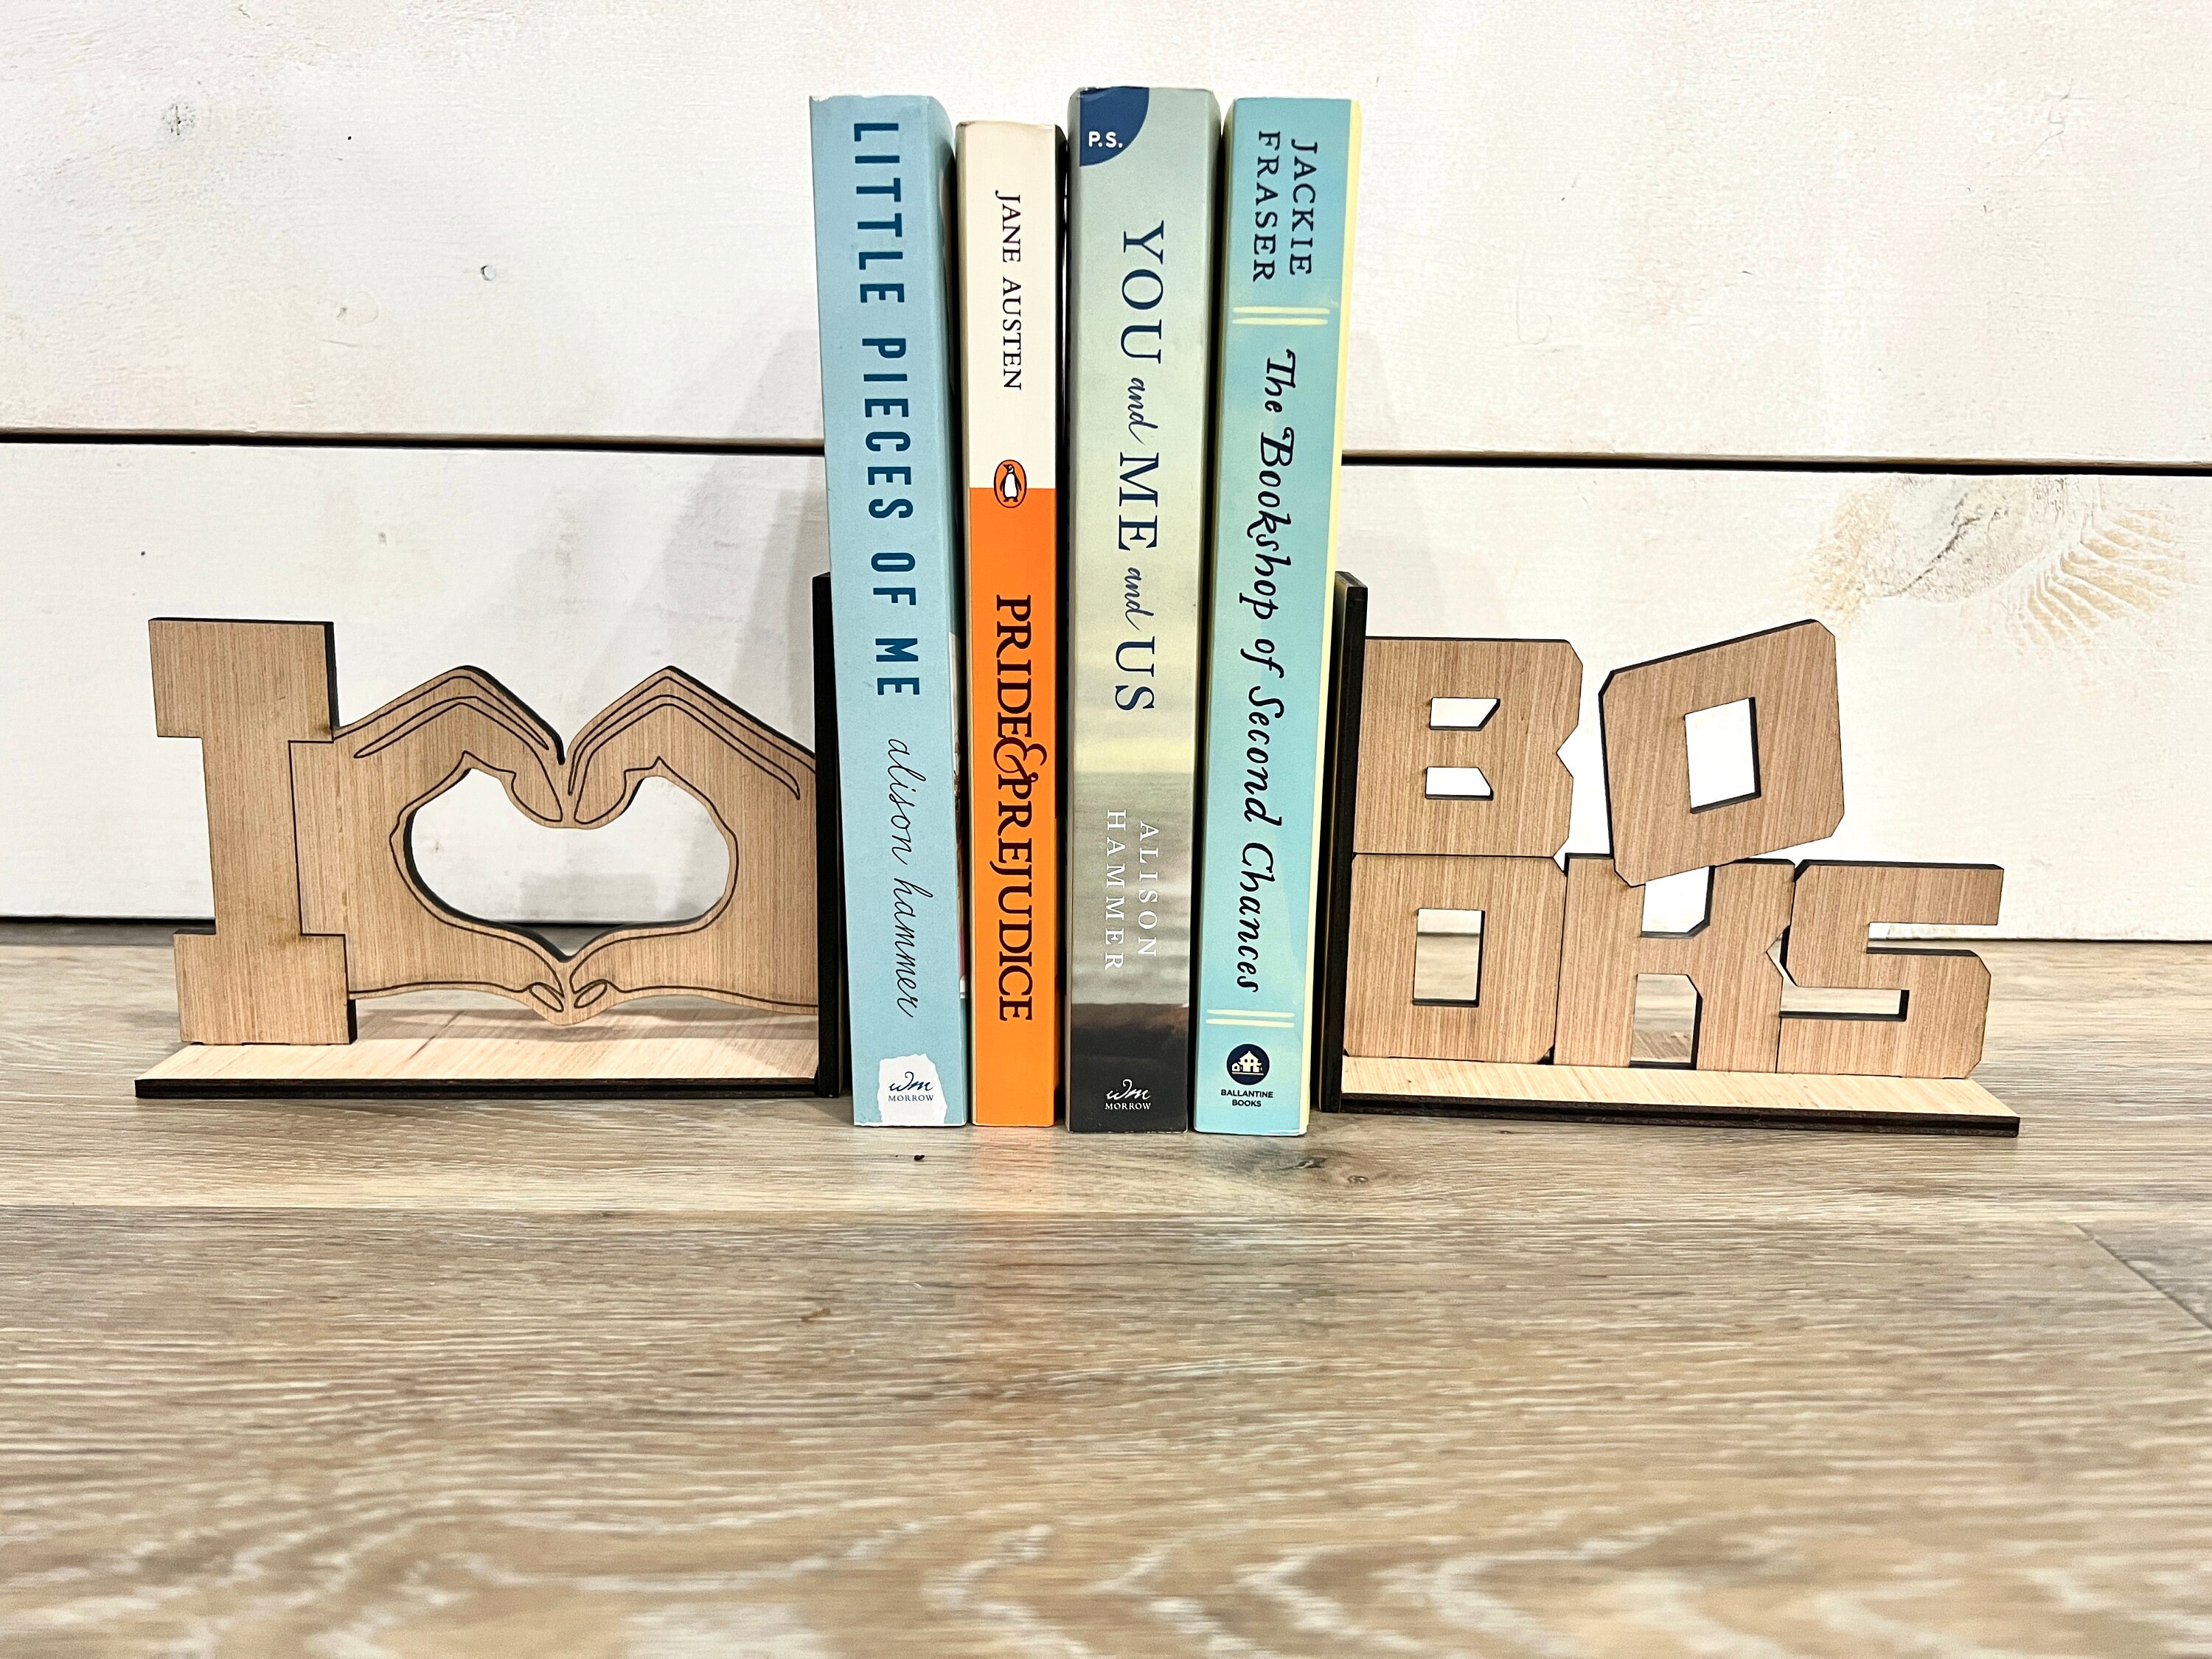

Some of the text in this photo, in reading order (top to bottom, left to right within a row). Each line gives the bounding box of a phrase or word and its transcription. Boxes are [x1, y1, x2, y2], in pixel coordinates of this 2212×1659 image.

[1088, 131, 1123, 149] P.S.
[1253, 131, 1281, 283] FRASER
[1289, 139, 1317, 276] JACKIE
[995, 190, 1022, 392] JANE AUSTEN
[853, 122, 921, 697] LITTLE PIECES OF ME
[1115, 220, 1165, 712] YOU and ME and US
[1237, 348, 1296, 993] The Bookshop of Second Chances
[888, 737, 933, 1018] alison hammer
[1103, 809, 1129, 971] HAMMER
[1138, 821, 1161, 959] ALISON
[887, 1094, 935, 1102] MORROW
[1104, 1101, 1152, 1111] MORROW
[1220, 1089, 1273, 1099] BALLANTINE
[1231, 1099, 1262, 1107] BOOKS
